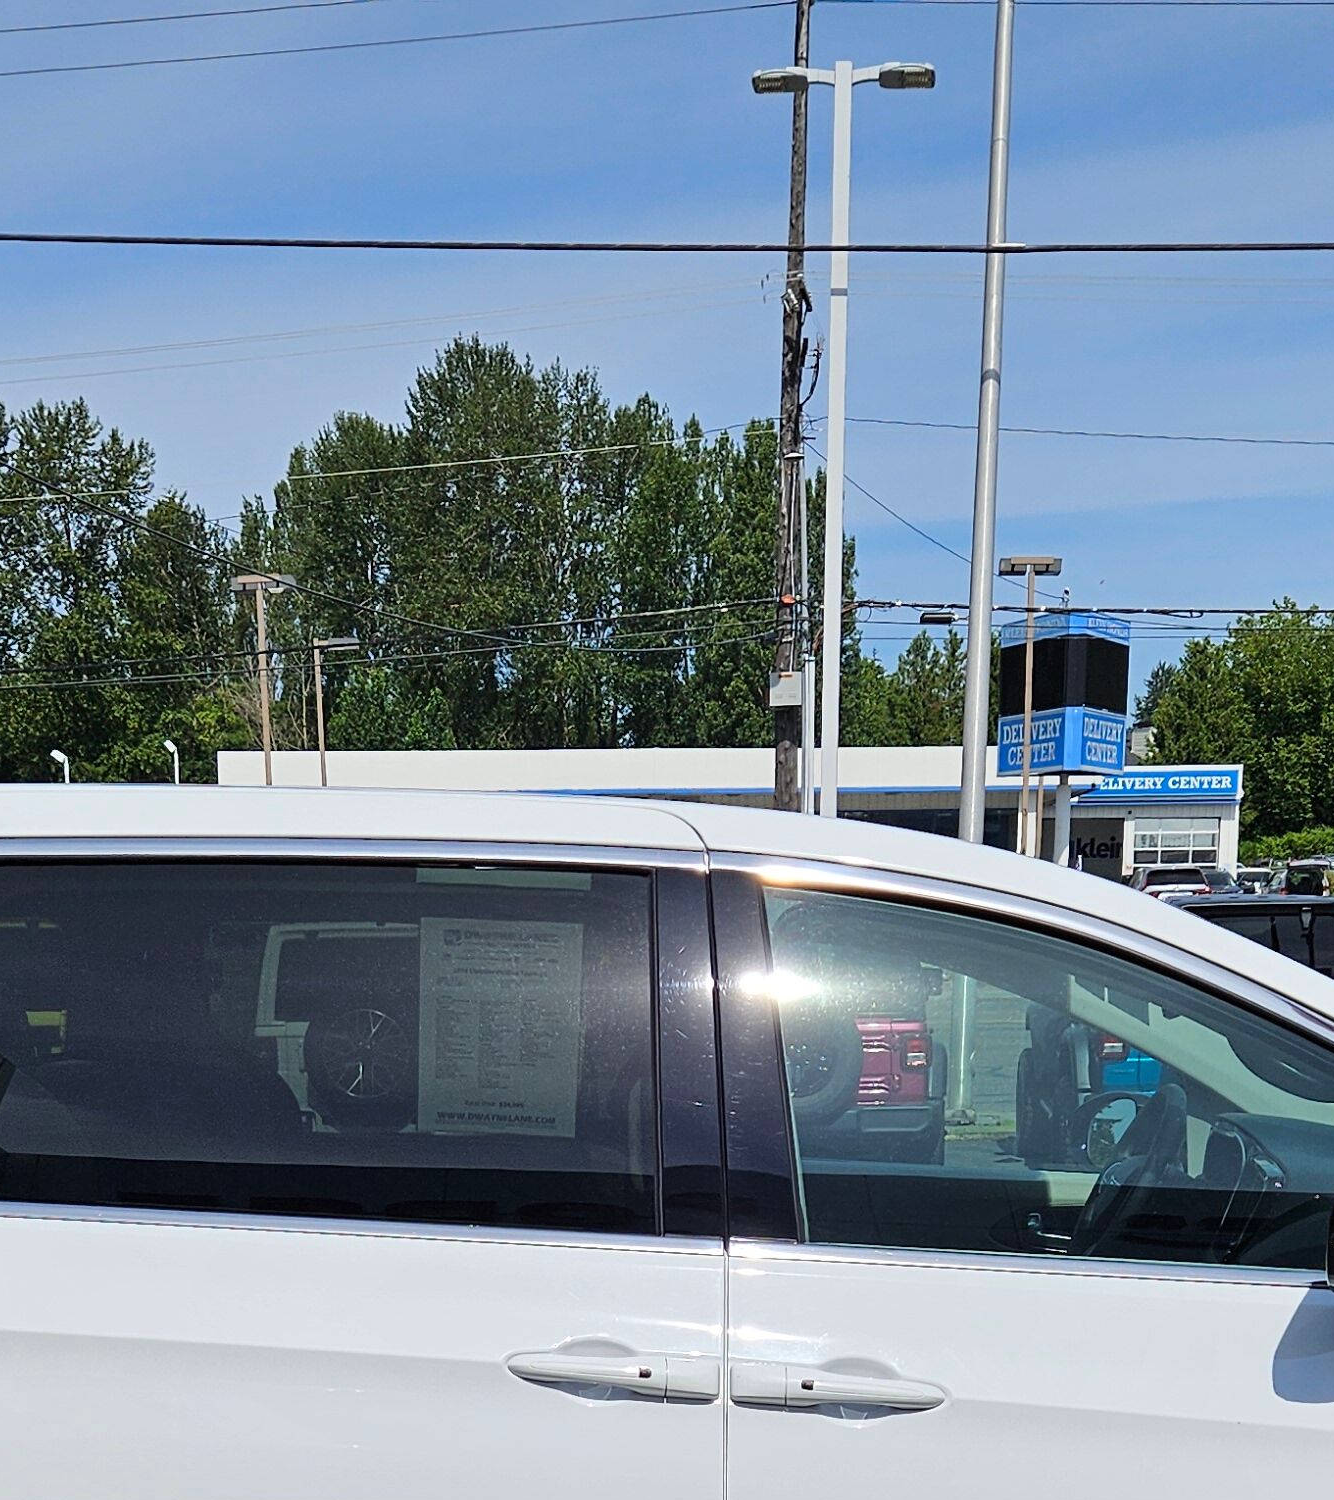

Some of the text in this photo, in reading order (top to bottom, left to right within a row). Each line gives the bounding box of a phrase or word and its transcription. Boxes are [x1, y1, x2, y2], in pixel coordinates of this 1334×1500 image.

[1003, 718, 1062, 745] DELVERY
[1083, 717, 1123, 742] DELIVERY
[1007, 741, 1056, 766] CETER
[1085, 741, 1118, 764] CENTER
[1099, 776, 1232, 790] ELIVERY CENTER
